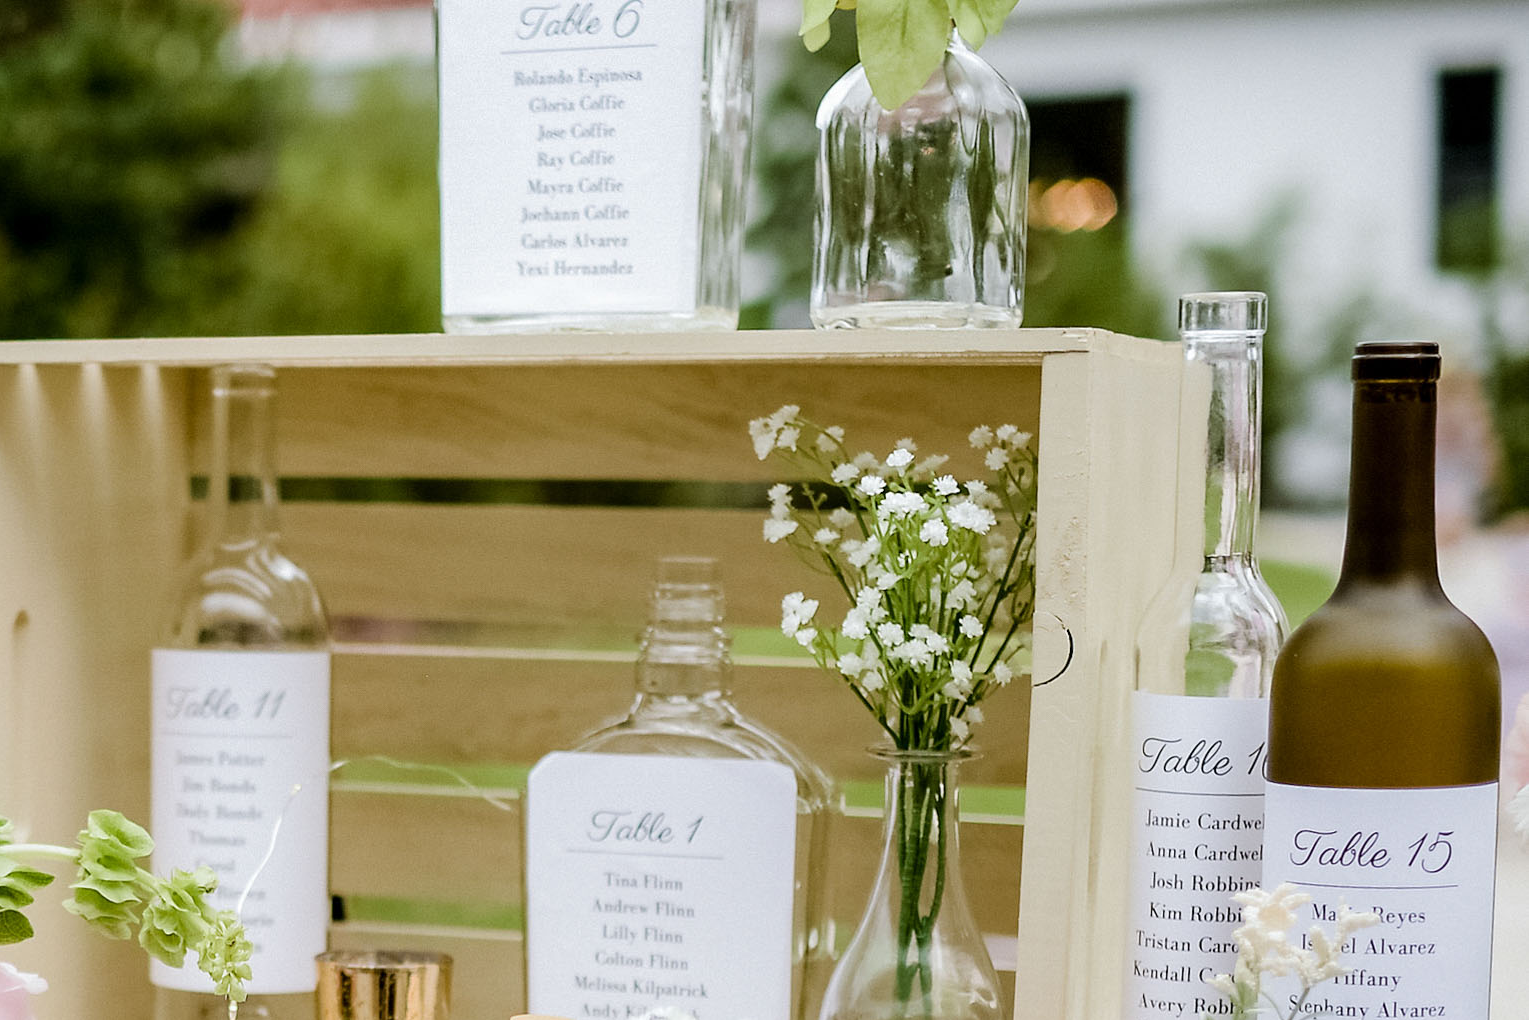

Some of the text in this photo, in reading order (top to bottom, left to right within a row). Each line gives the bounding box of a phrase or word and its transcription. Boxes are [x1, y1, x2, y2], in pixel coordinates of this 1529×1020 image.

[516, 0, 644, 40] Table 6
[514, 67, 642, 87] Rolando Espinosa
[529, 96, 625, 113] Gloria Coffie
[537, 124, 616, 141] Jose Coffie
[537, 151, 614, 170] Ray Coffie
[579, 178, 624, 193] Coffie
[584, 205, 629, 220] Coffie
[521, 235, 628, 249] Carlos Alvarez
[554, 262, 633, 276] Hernandez
[166, 686, 286, 721] Table 11
[1138, 737, 1232, 776] Table
[587, 809, 704, 843] Table 1
[1146, 809, 1190, 828] Jamie
[1147, 842, 1186, 859] Anna
[1290, 829, 1455, 873] Table 15
[604, 872, 682, 891] Tina Flinn
[1150, 872, 1260, 891] Josh Robbins
[592, 900, 695, 918] Andrew Flinn
[1150, 902, 1182, 920] Kim
[1373, 907, 1426, 929] Reyes
[603, 925, 682, 944] Lilly Flinn
[1137, 930, 1190, 952] Tristan
[1365, 939, 1436, 954] Alvarez
[595, 952, 688, 971] Colton Flinn
[1134, 960, 1191, 982] Kendall
[575, 976, 708, 999] Melissa Kilpatrick
[1139, 993, 1186, 1018] Avery
[1376, 1002, 1445, 1018] Alvarez
